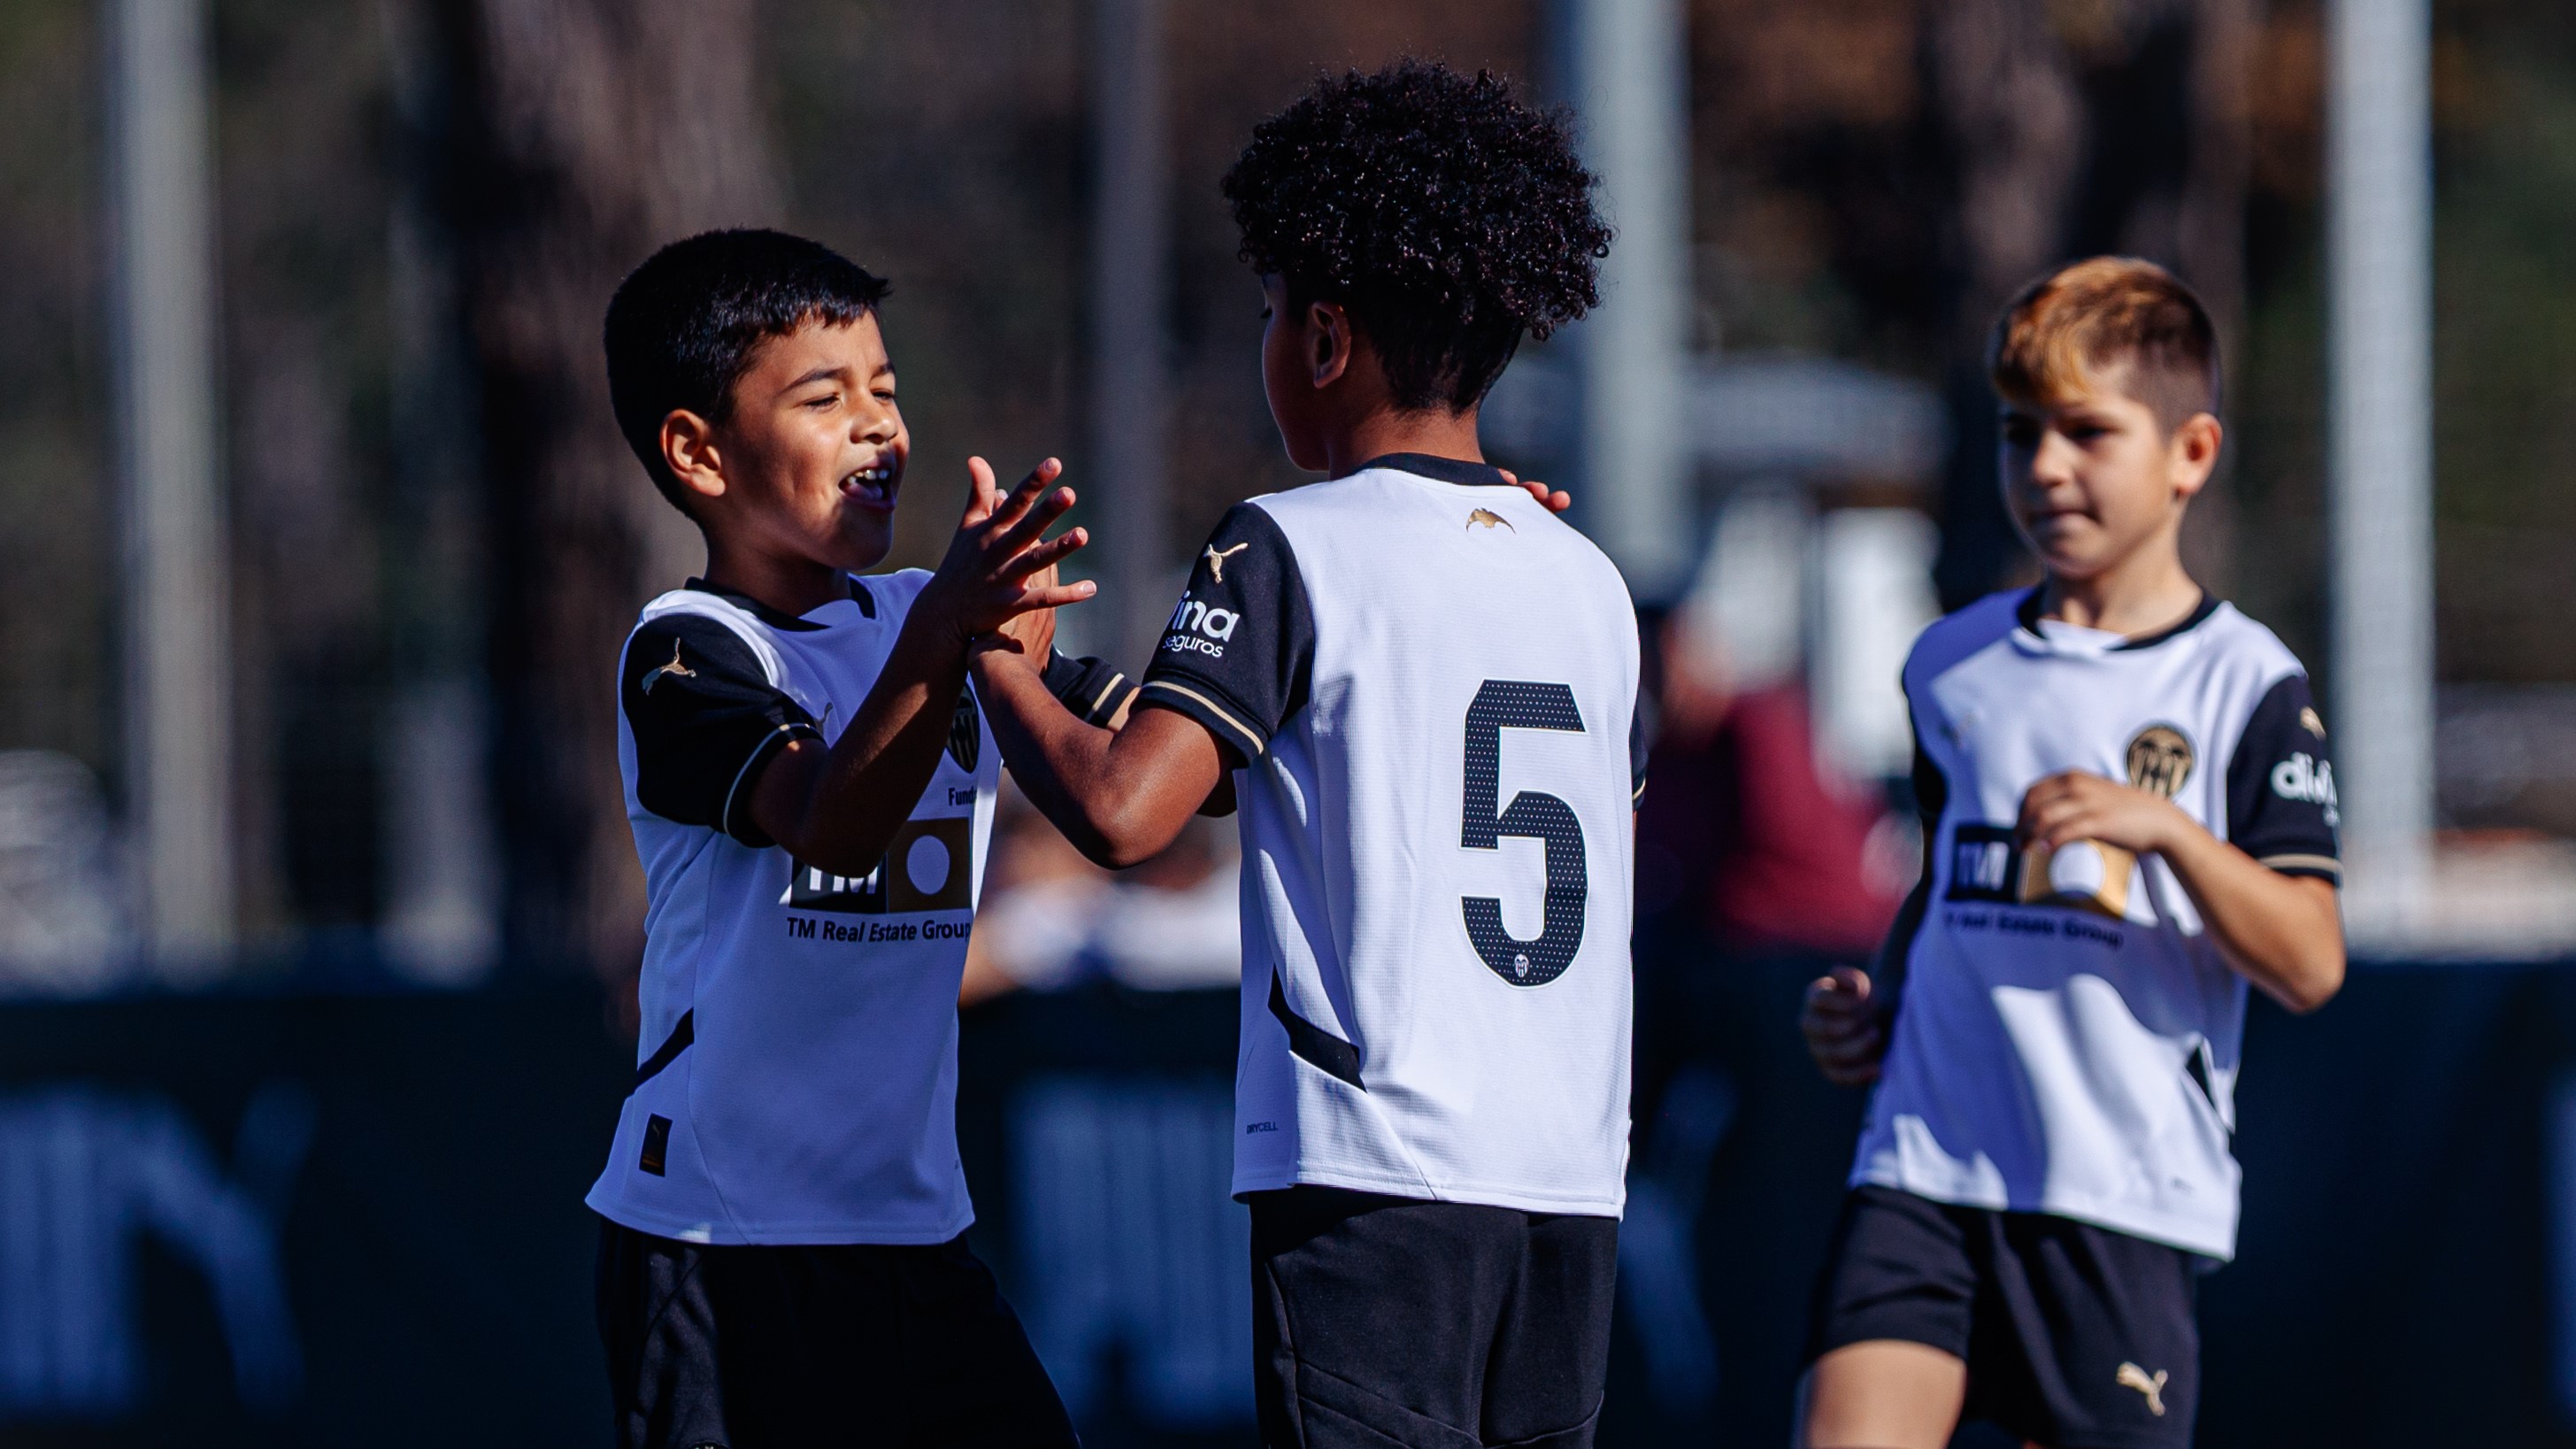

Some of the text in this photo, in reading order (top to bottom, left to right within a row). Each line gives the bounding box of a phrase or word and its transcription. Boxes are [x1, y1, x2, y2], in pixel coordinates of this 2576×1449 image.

[1169, 590, 1240, 643] ina
[1459, 678, 1588, 987] 5
[787, 917, 817, 939] TM
[822, 921, 865, 942] Real
[868, 921, 918, 943] Estate
